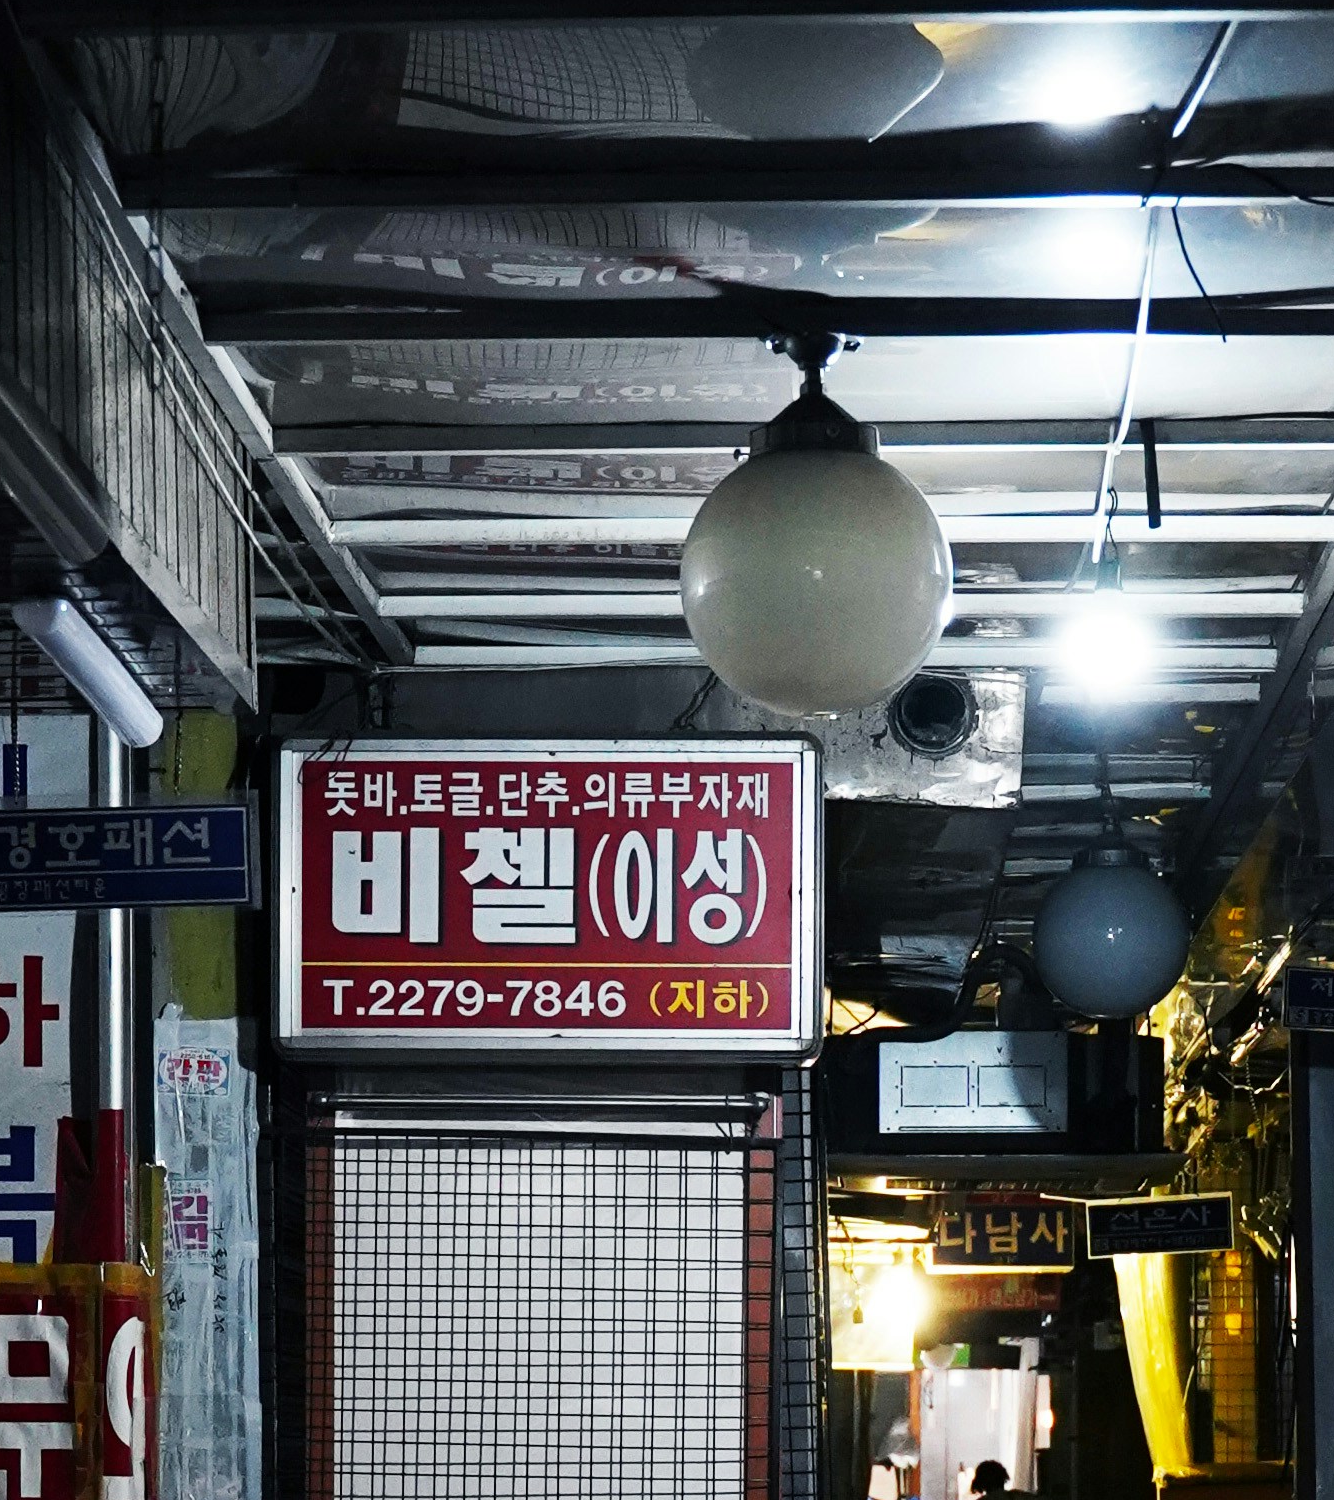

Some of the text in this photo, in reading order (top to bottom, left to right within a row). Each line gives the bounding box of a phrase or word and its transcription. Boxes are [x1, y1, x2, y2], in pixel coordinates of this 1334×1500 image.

[324, 770, 770, 819] 돗바.토글.단추.의류부자재
[323, 978, 770, 1020] T.2279-7846 (지하)
